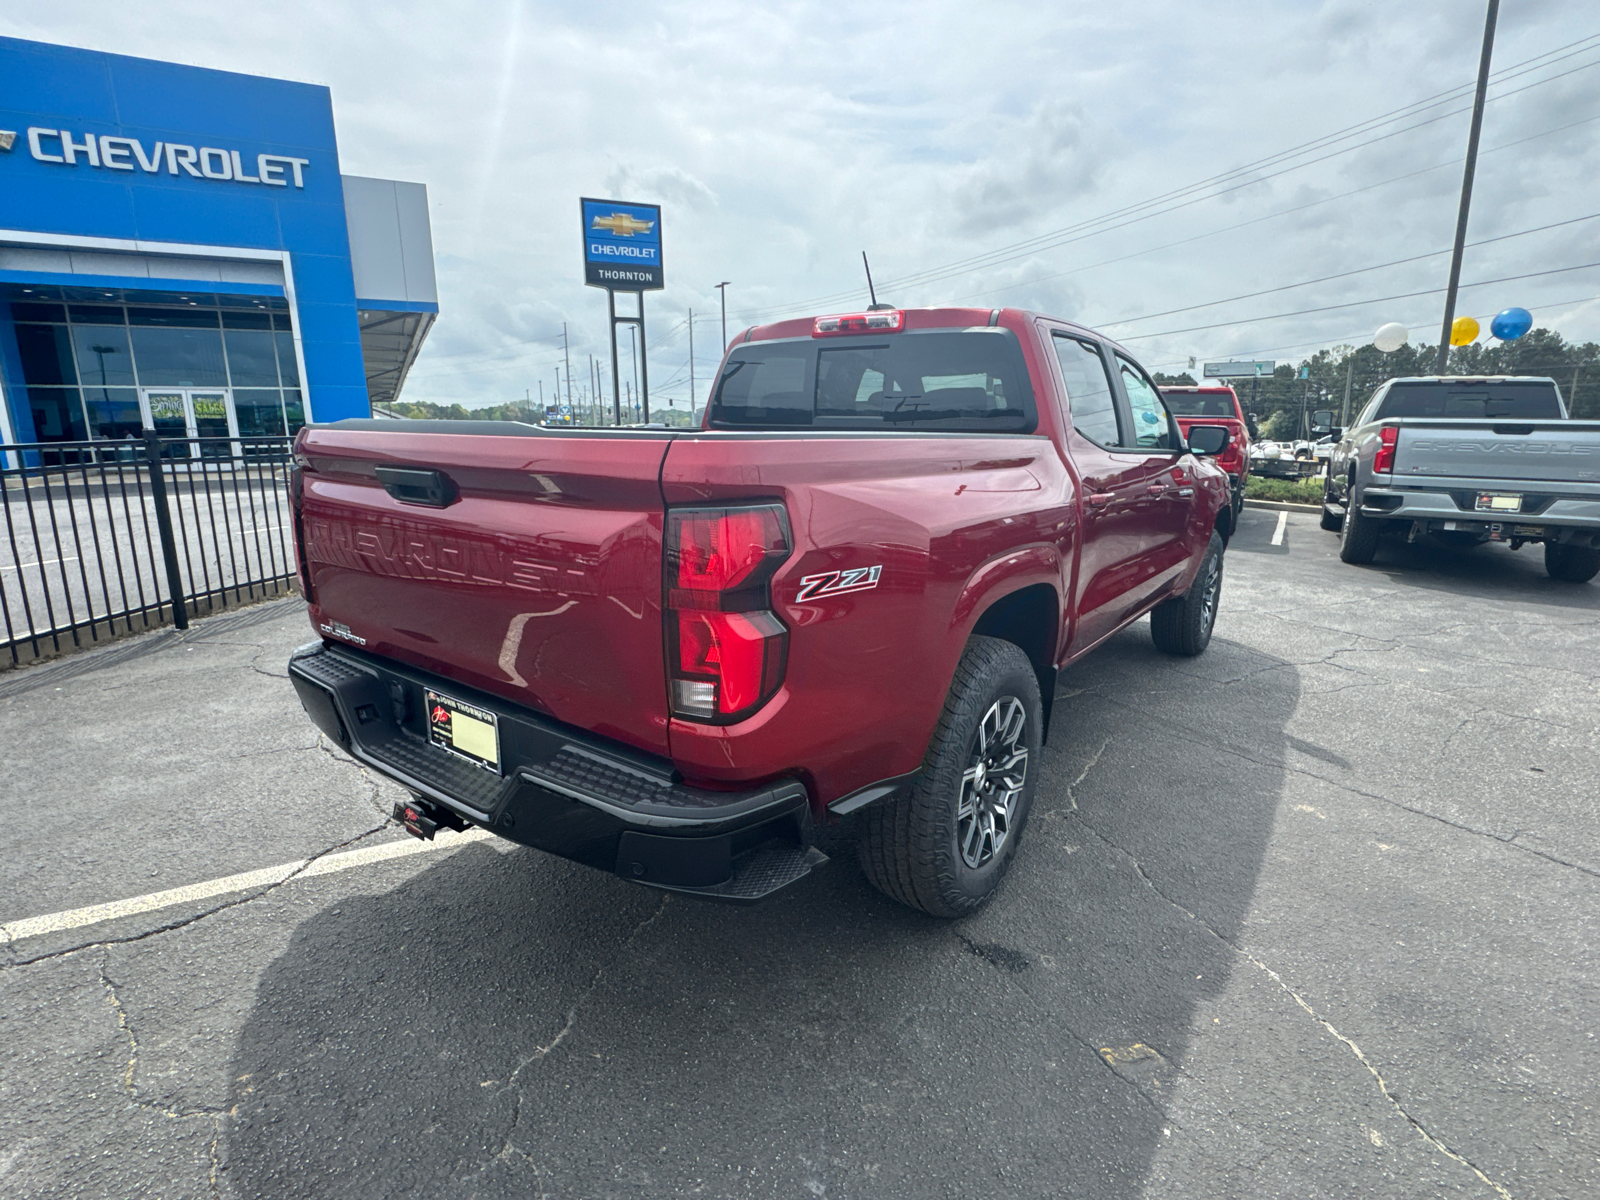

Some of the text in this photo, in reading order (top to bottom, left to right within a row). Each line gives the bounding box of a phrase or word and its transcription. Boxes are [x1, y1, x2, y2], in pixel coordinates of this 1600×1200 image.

[27, 126, 309, 188] CHEVROLET
[591, 244, 656, 258] CHEVROLET
[598, 269, 653, 281] THORNTON
[1410, 440, 1600, 455] CHEVROLE
[795, 565, 883, 603] Z71
[439, 695, 457, 708] JOHN
[456, 702, 493, 722] THORNTON
